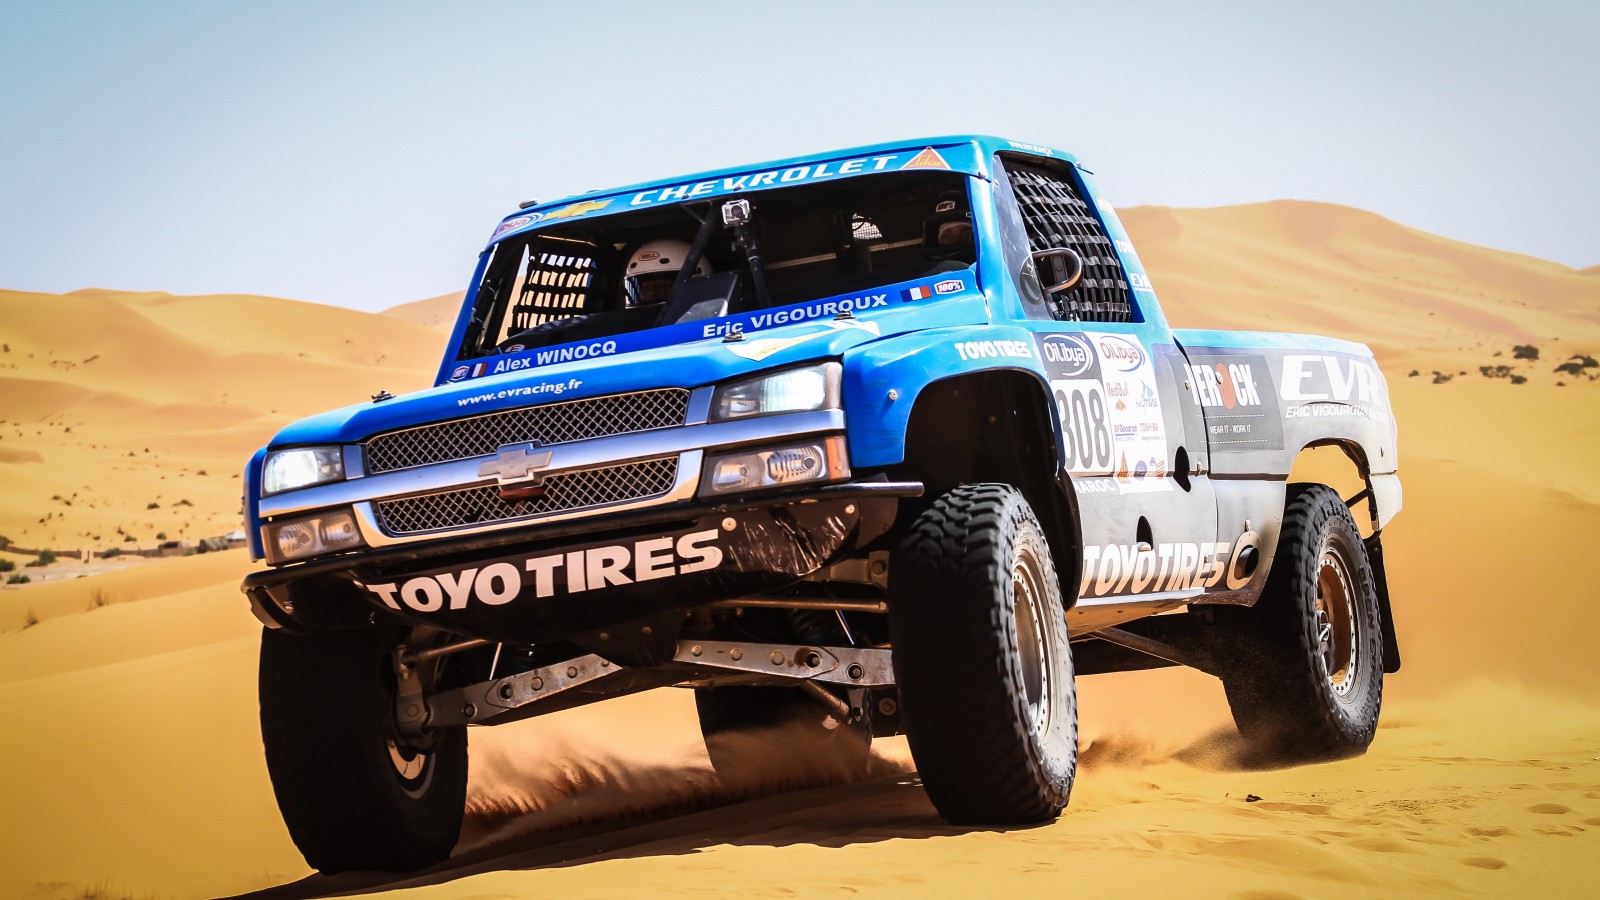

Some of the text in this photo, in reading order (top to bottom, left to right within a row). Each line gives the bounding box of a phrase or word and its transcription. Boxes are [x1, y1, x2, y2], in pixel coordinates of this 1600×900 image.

[909, 154, 942, 167] Sika
[630, 155, 898, 206] CHEVROLET
[937, 281, 962, 292] 100%
[703, 294, 889, 338] Eric VIGOUROUX
[493, 357, 532, 374] Alex
[536, 340, 617, 366] WINOCQ
[954, 340, 1032, 361] TOYO TIRES
[457, 378, 583, 408] www.evracing.fr
[1279, 354, 1384, 408] EVR
[1055, 388, 1111, 470] 308
[1210, 425, 1224, 434] WEAR
[1232, 424, 1247, 434] WORK
[1285, 406, 1310, 419] ERIC
[366, 529, 723, 612] TOYO TIRES
[1080, 542, 1231, 596] TOYO TIRES
